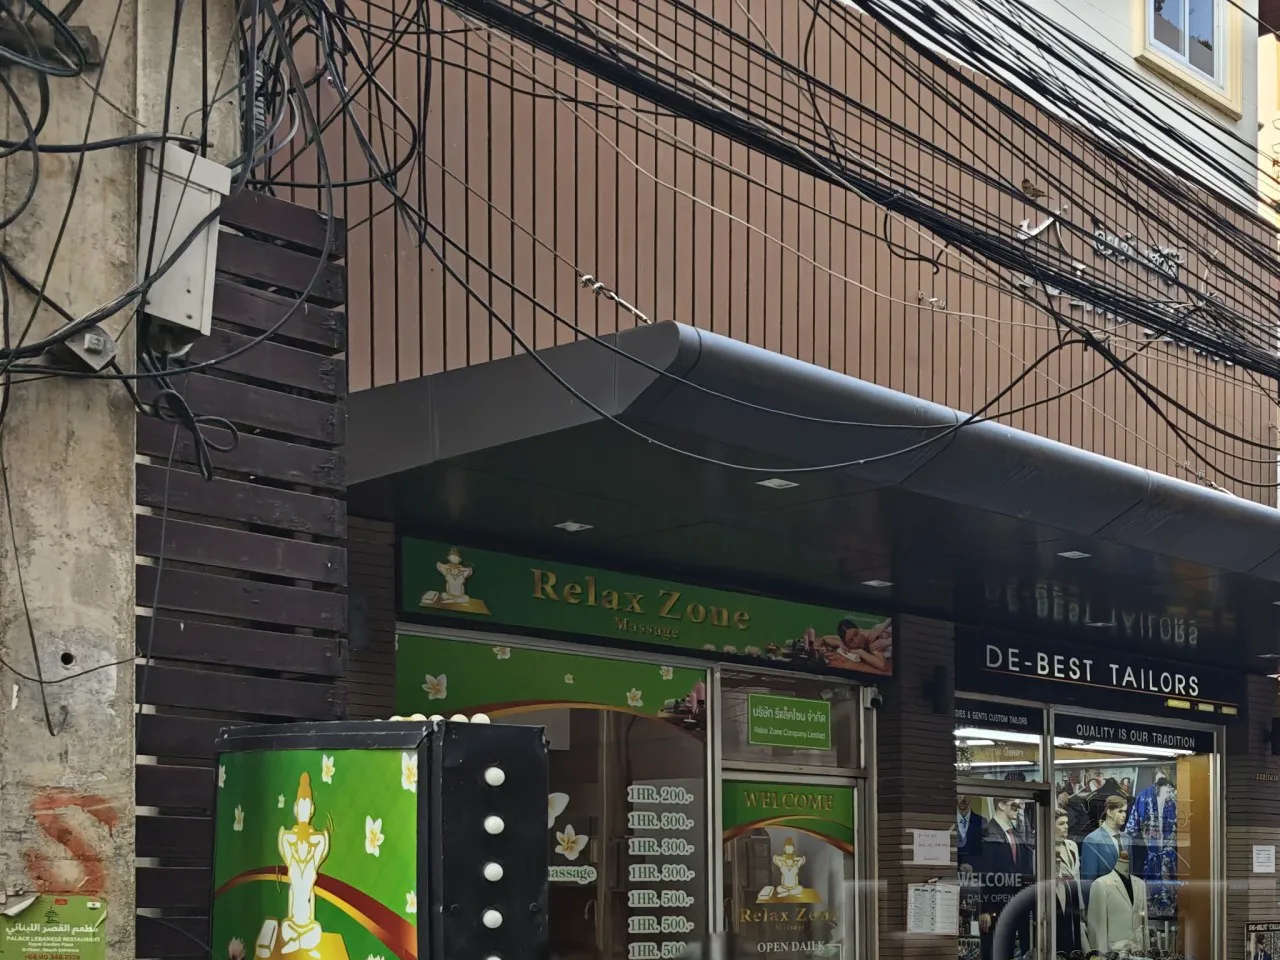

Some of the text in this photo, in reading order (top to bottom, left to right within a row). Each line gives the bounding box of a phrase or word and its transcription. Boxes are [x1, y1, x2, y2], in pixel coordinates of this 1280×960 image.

[531, 568, 751, 630] Relax Zone
[614, 615, 680, 639] Massage
[986, 644, 1200, 697] DE-BEST TAILORS
[972, 712, 988, 720] GENTS
[988, 713, 1009, 723] CUSTOM
[1009, 715, 1028, 725] TAILORS
[769, 727, 783, 736] Zone
[783, 728, 807, 739] Company
[1075, 723, 1196, 748] QUALITY IS OUR TRADITION
[629, 787, 694, 803] 1HR. 200.-
[743, 790, 835, 811] WELCOME
[629, 813, 694, 829] 1HR. 300.-
[629, 839, 694, 855] 1HR. 300.-
[548, 867, 596, 884] assage
[629, 865, 694, 881] 1HR. 300.-
[957, 871, 1022, 888] WELCOME
[629, 891, 694, 907] 1HR. 500.-
[740, 907, 789, 923] Relax
[629, 917, 694, 933] 1HR. 500.-
[629, 943, 660, 959] 1HR.
[757, 941, 789, 953] OPEN
